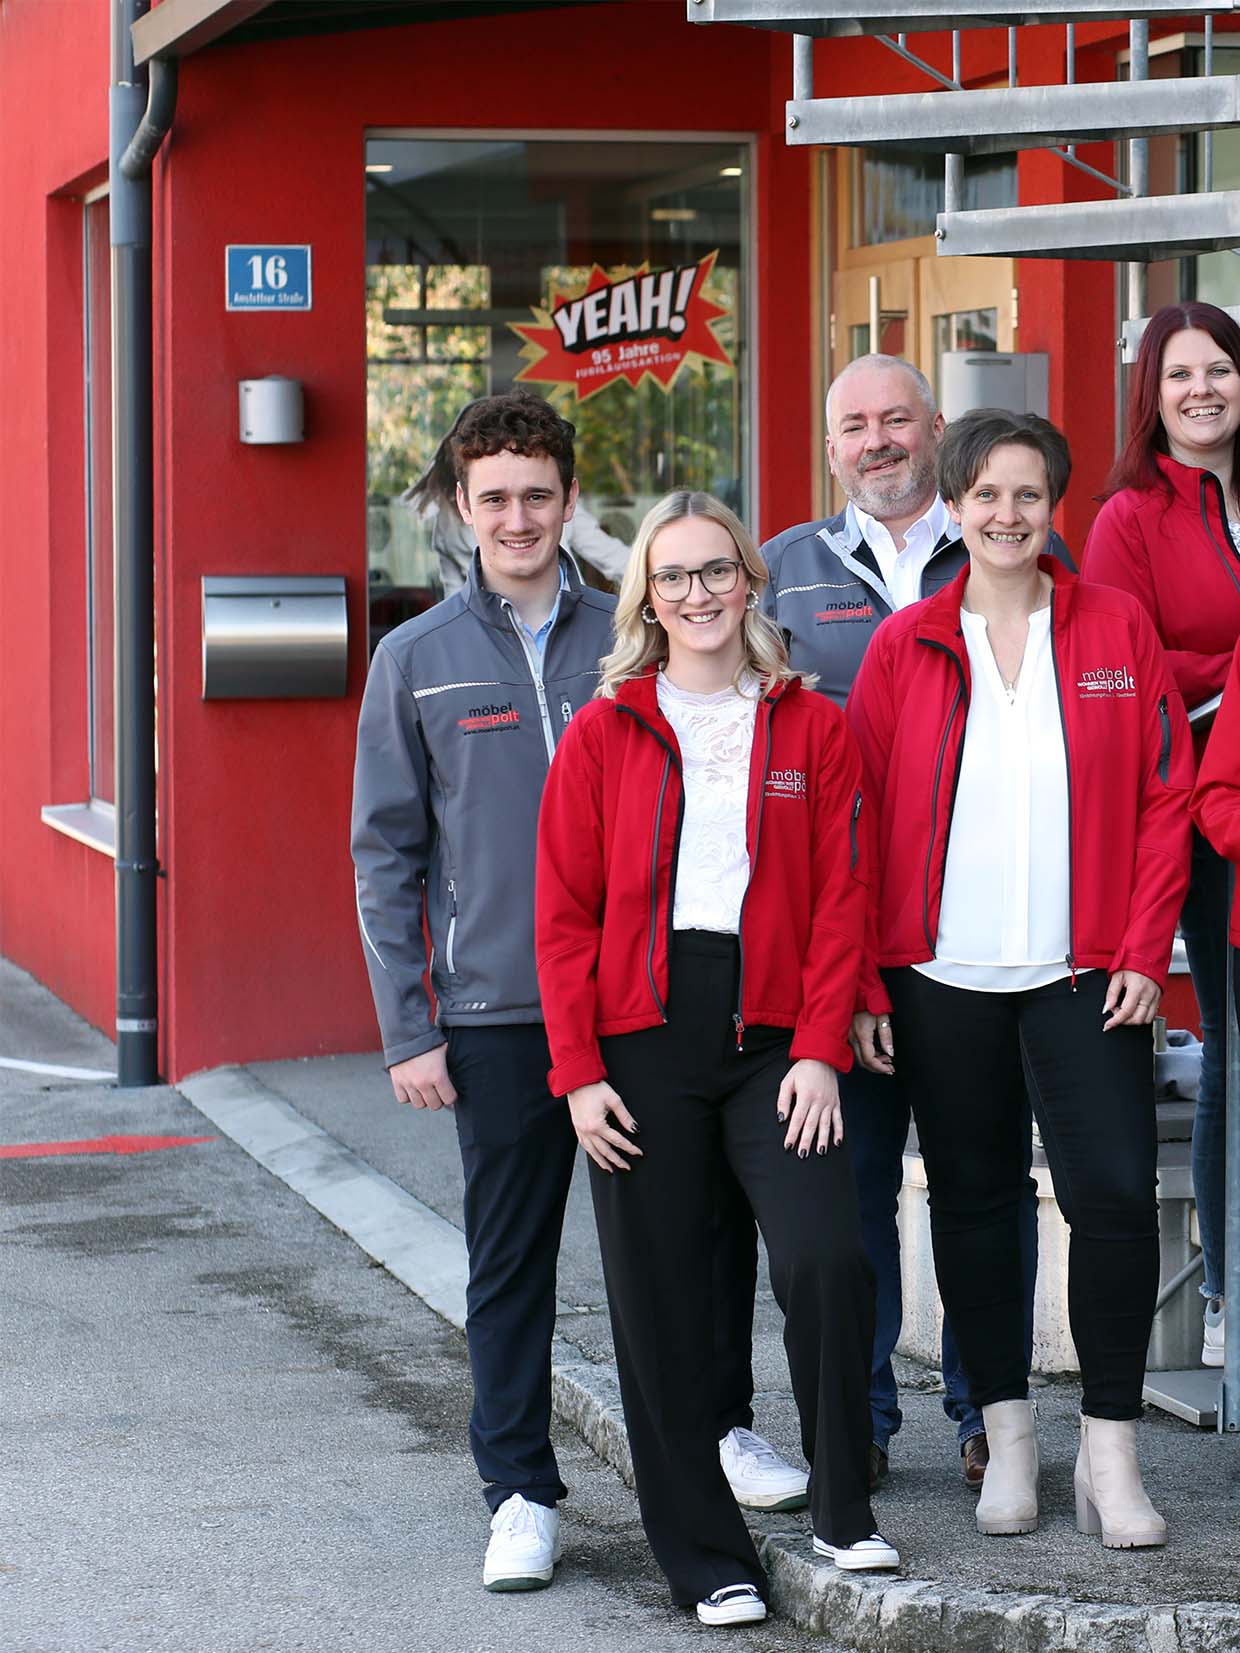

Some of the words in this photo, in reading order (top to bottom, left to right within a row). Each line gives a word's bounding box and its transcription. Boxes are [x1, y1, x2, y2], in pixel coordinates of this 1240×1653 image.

[247, 255, 288, 290] 16
[553, 266, 698, 350] YEAH!
[592, 350, 612, 365] 95
[618, 342, 660, 361] Jahre
[826, 598, 867, 611] möbel
[847, 606, 873, 618] polt
[1082, 666, 1128, 681] möbel
[1108, 676, 1135, 692] polt
[469, 702, 512, 717] möbel
[492, 710, 520, 726] polt
